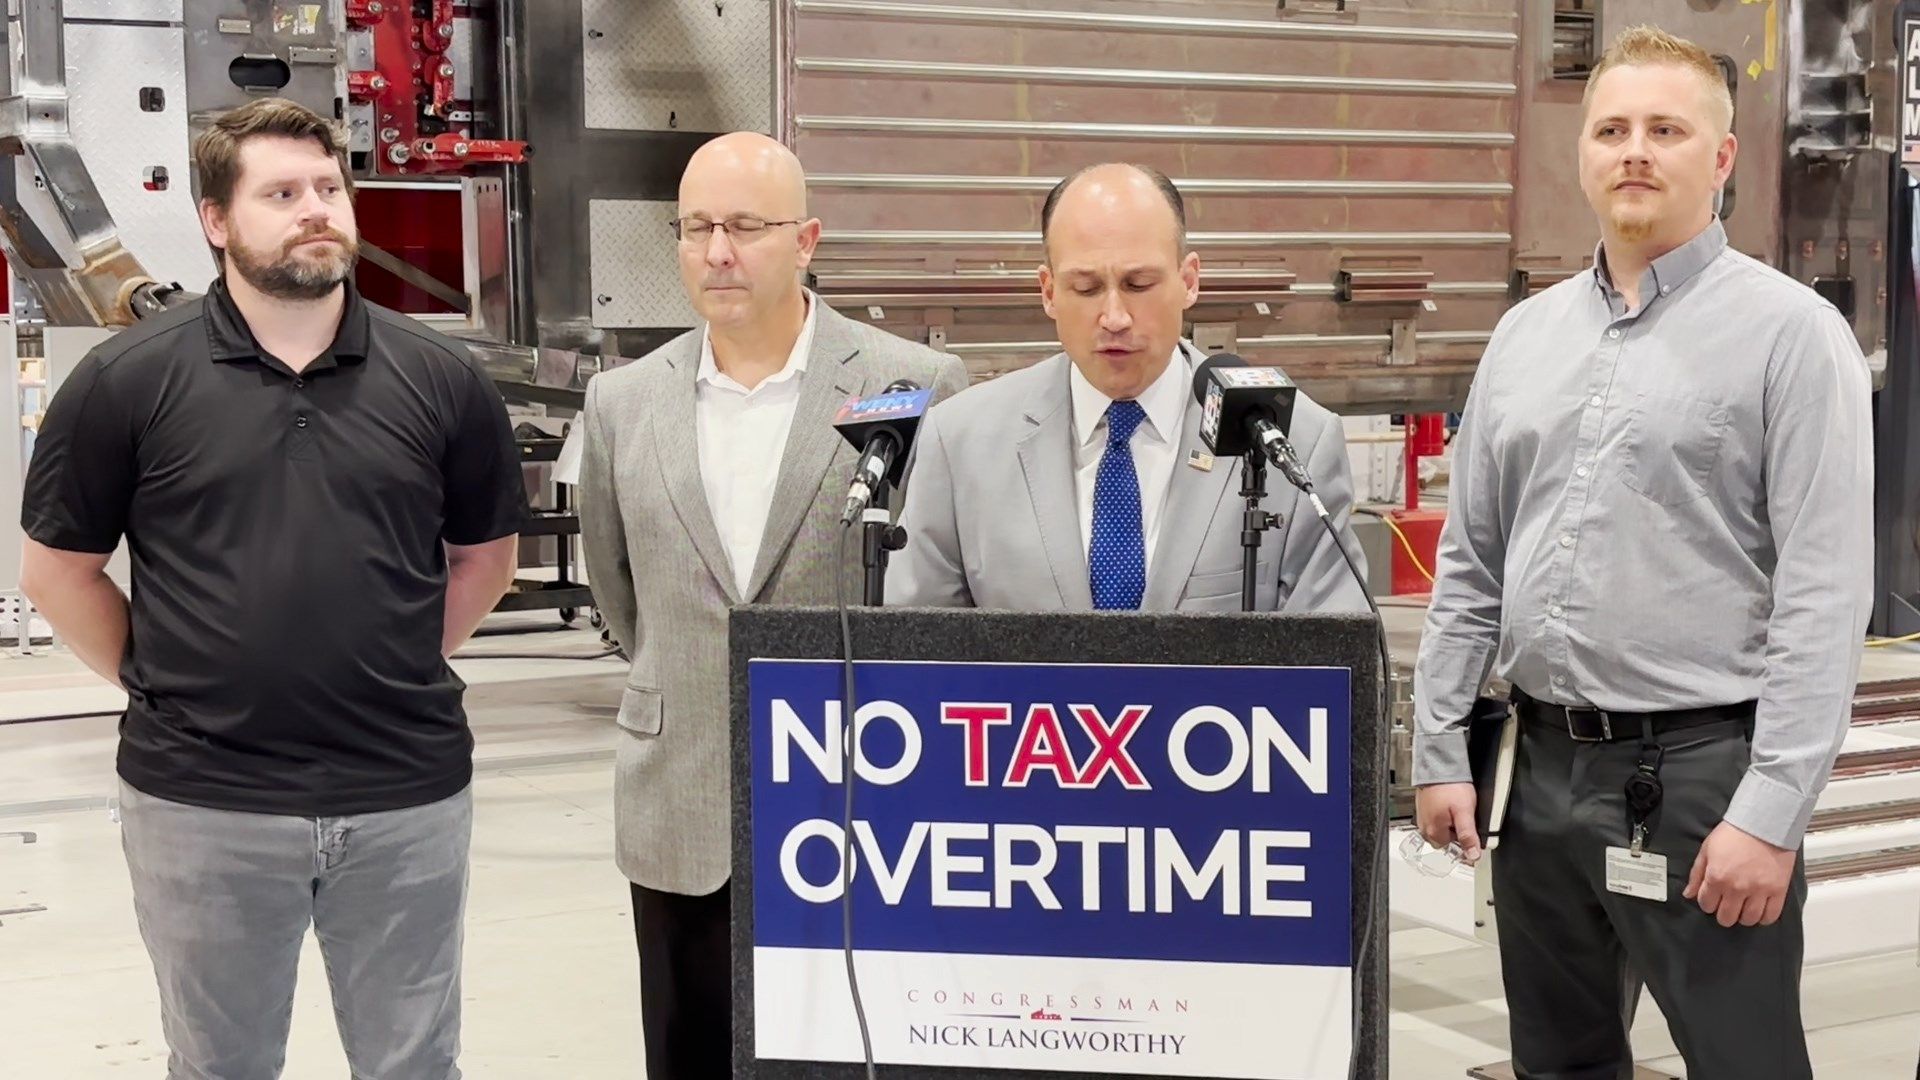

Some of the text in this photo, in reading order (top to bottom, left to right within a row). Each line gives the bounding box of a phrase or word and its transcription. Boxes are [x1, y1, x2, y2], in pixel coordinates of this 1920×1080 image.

[771, 699, 1329, 795] NO TAX ON
[779, 818, 1314, 918] OVERTIME
[907, 988, 1190, 1013] CONGRESSMAN
[909, 1024, 1187, 1055] NICK LANGWORTHY
